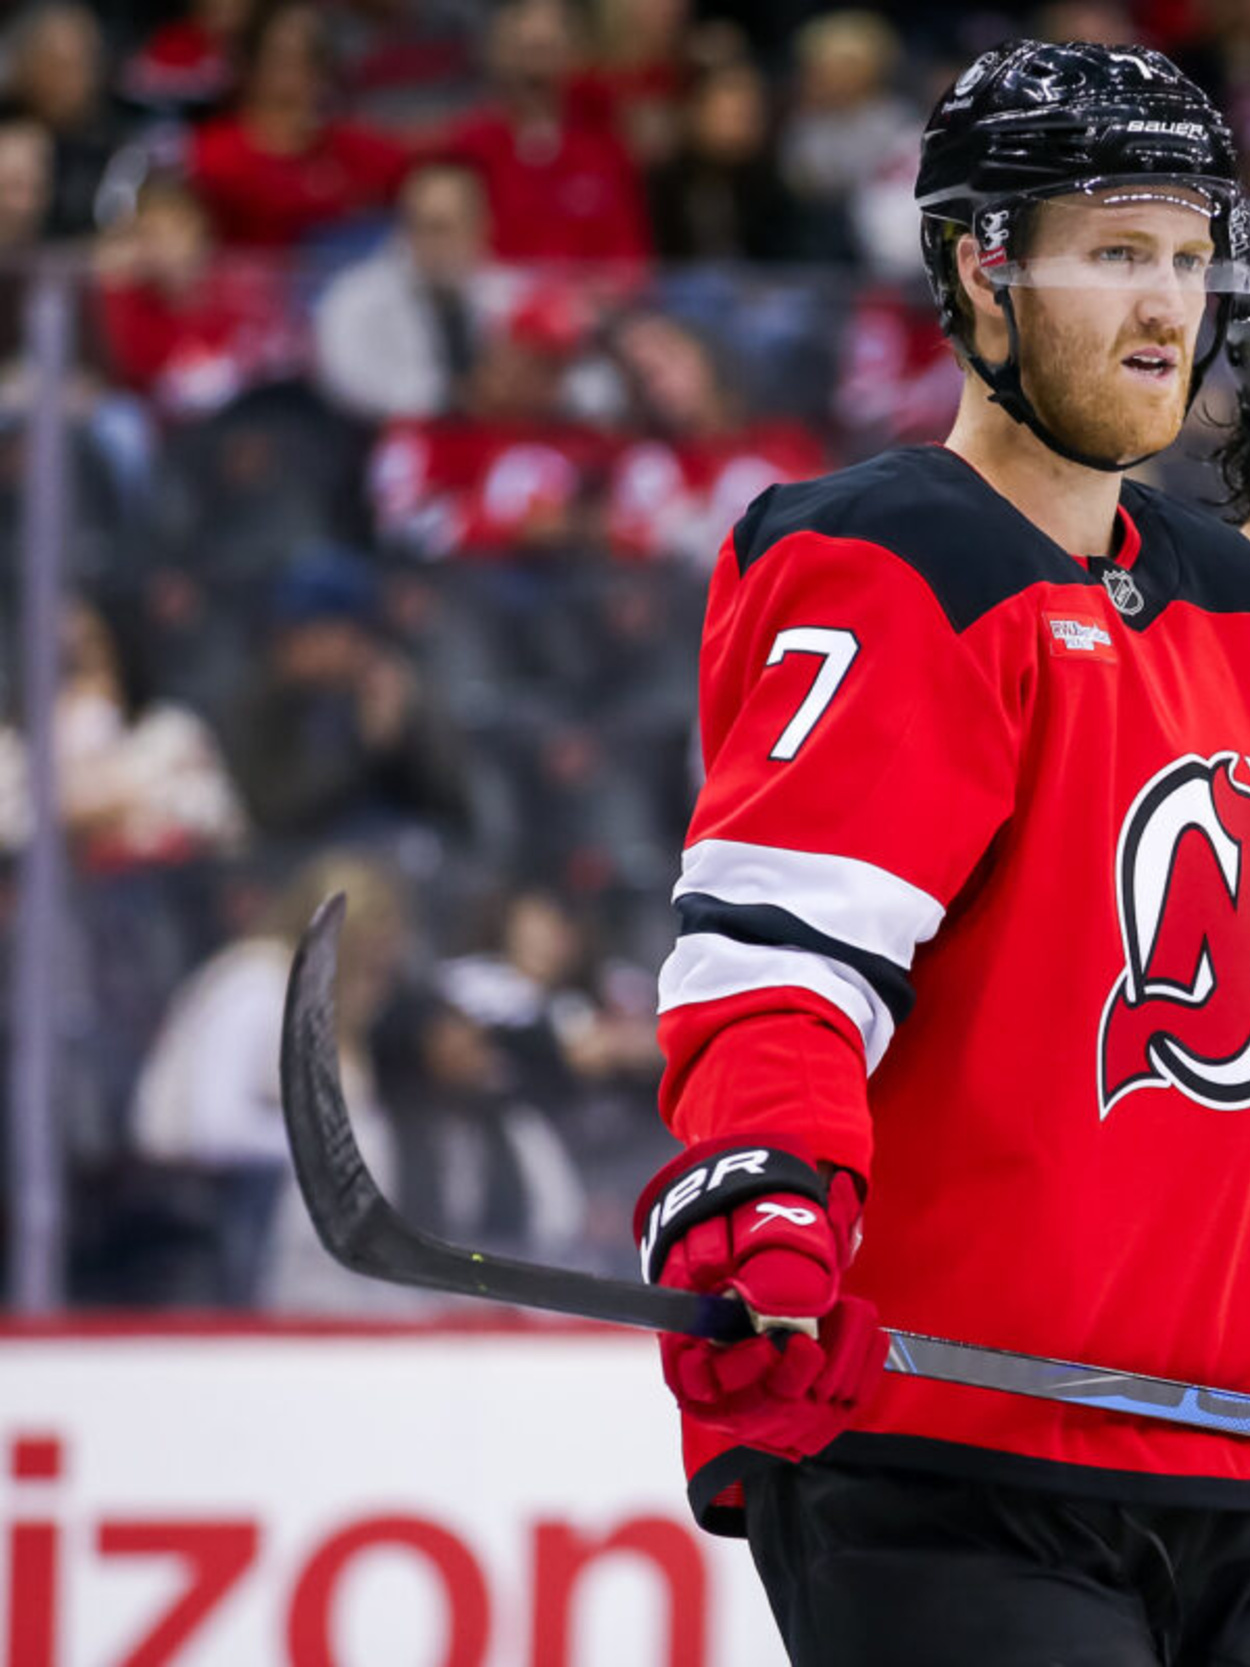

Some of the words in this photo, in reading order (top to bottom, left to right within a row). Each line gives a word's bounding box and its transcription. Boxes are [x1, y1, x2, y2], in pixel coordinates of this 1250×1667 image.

[1127, 120, 1203, 140] BAUER
[765, 624, 861, 763] 7
[8, 1436, 709, 1667] izon
